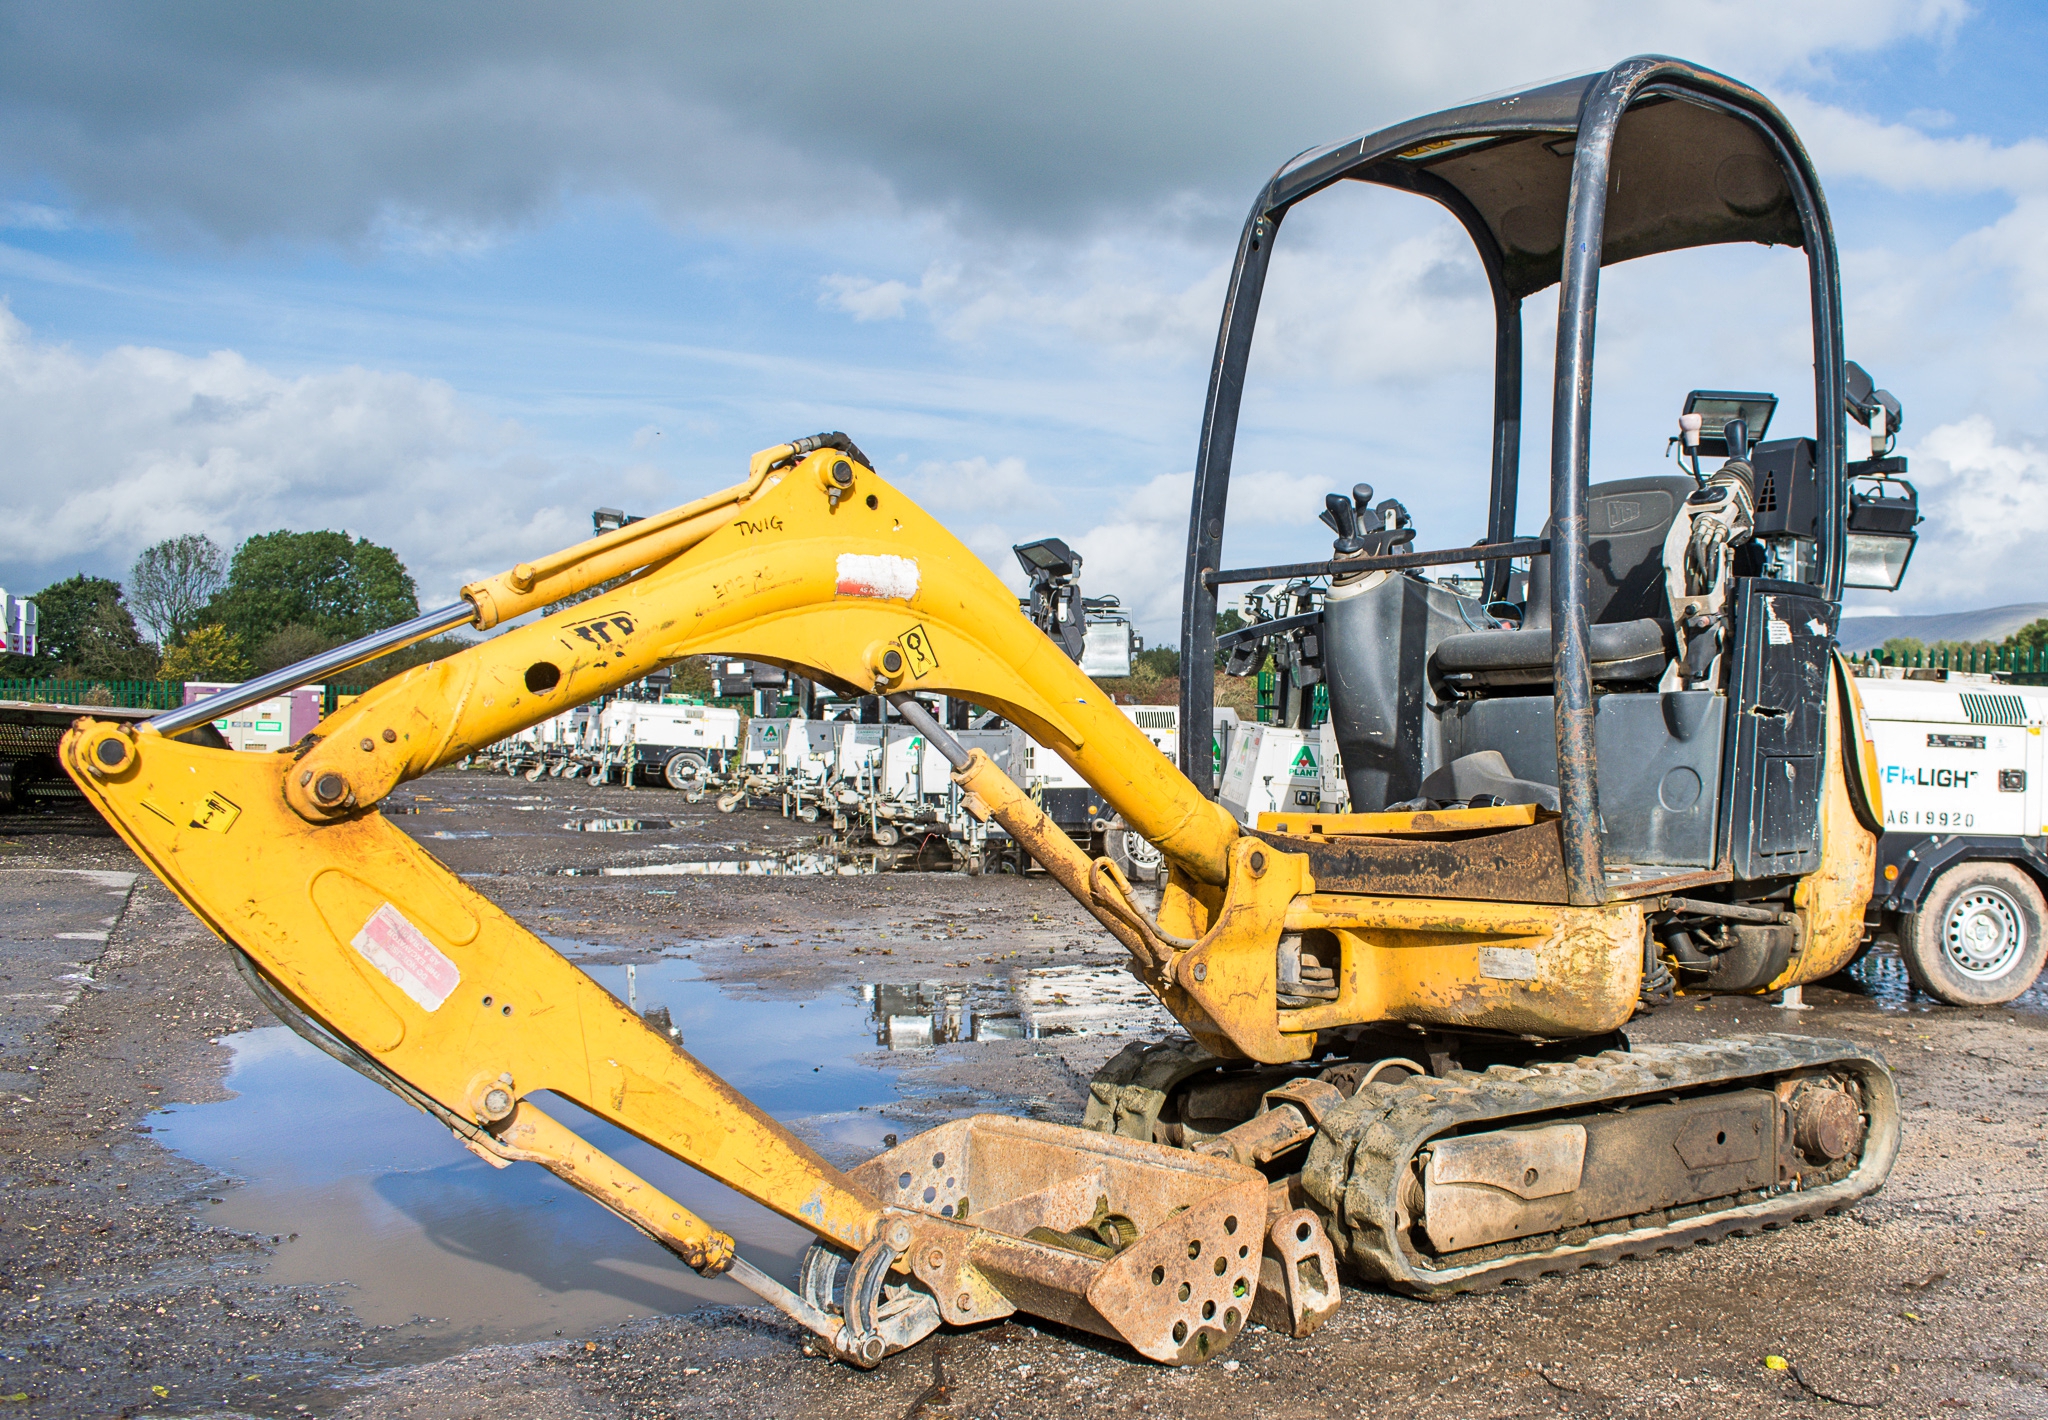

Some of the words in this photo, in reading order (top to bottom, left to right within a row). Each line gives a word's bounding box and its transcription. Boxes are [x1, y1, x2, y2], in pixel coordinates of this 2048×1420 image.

[733, 515, 783, 536] TWIG
[1288, 768, 1318, 777] PLANT
[386, 928, 426, 965] EXCAVATOR
[422, 949, 430, 957] A
[401, 955, 417, 970] NOT
[428, 954, 440, 966] AS
[416, 968, 428, 980] DO
[425, 963, 441, 979] THIS
